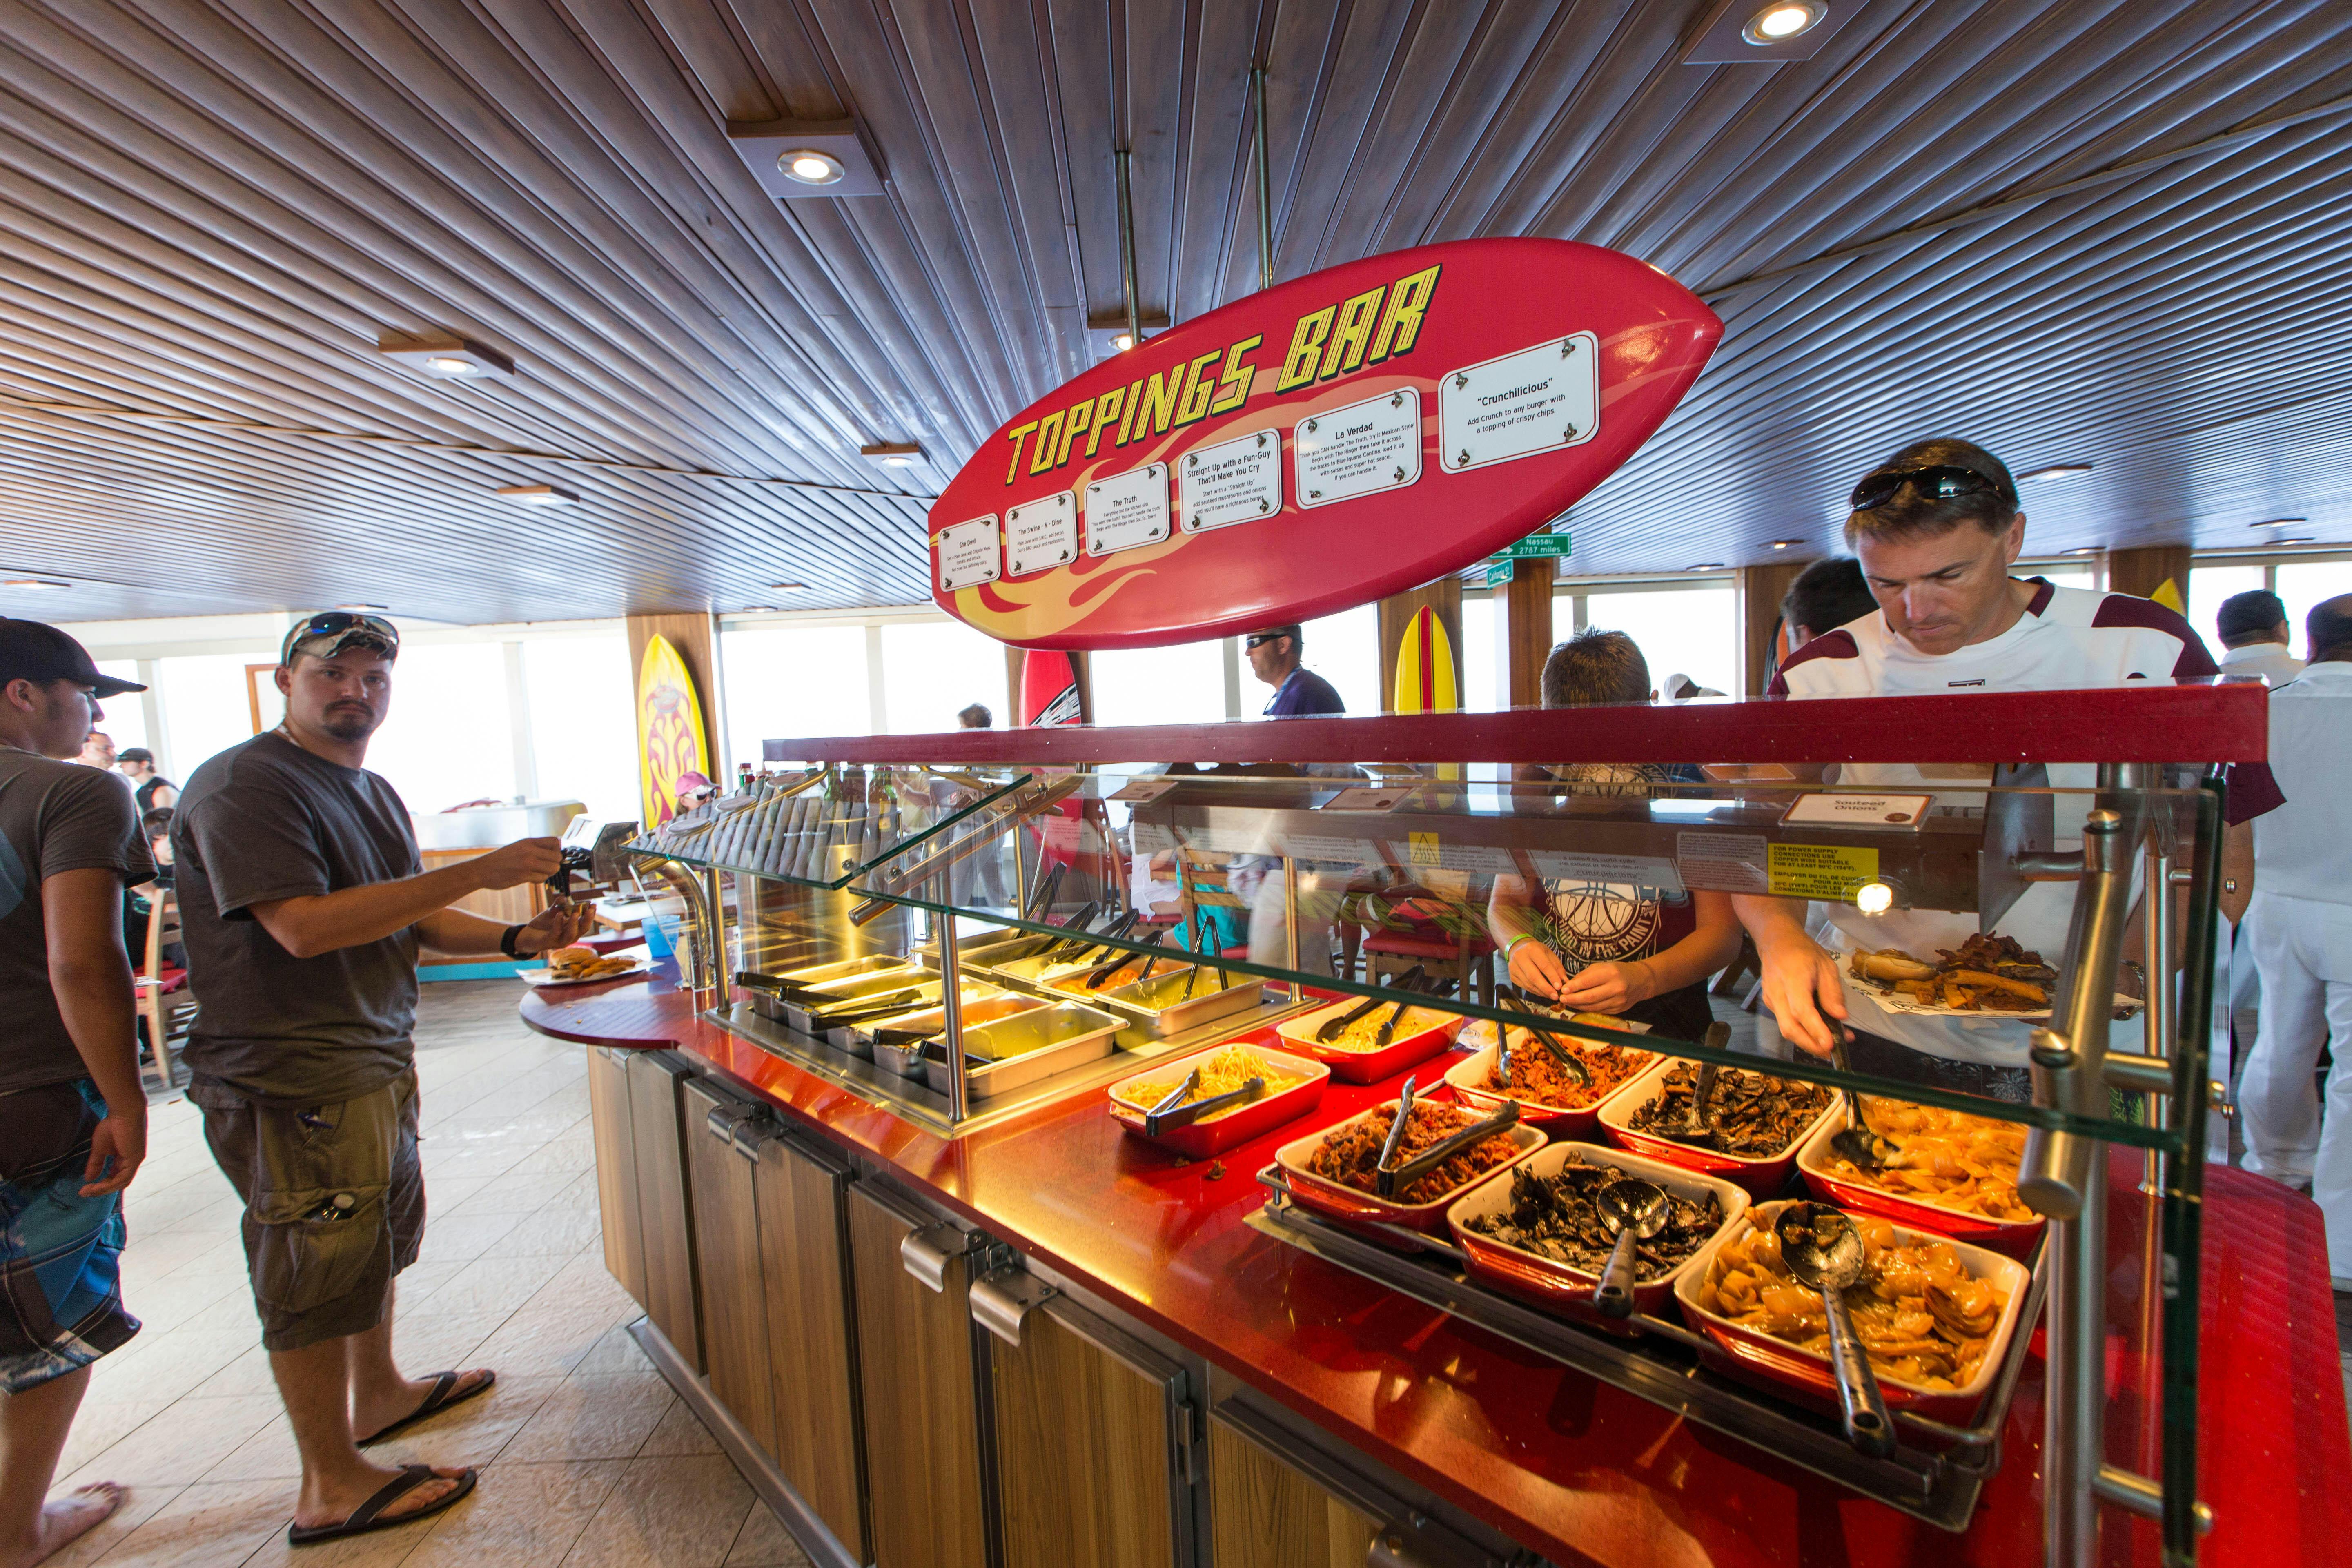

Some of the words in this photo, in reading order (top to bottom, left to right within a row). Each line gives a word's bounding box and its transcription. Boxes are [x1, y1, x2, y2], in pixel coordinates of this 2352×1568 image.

[1005, 333, 1263, 486] TOPPINGS
[1275, 263, 1443, 395] BAR
[1468, 417, 1479, 425] Add
[1481, 411, 1503, 421] Crunch
[1527, 400, 1547, 410] burger
[1550, 394, 1565, 403] with
[1347, 422, 1373, 436] Verdad
[1483, 422, 1506, 432] topping
[1517, 414, 1535, 423] crispy
[1537, 409, 1555, 417] chips.
[1188, 466, 1210, 478] Straight
[1213, 464, 1220, 472] Up
[1223, 459, 1236, 468] with
[1244, 451, 1270, 463] Fun-Guy
[1198, 475, 1215, 486] That'll
[1218, 472, 1233, 480] Make
[1249, 465, 1259, 473] Cry
[1124, 496, 1137, 504] Truth
[1218, 492, 1242, 501] mushrooms
[1229, 499, 1249, 507] righteous
[1519, 546, 1538, 555] 2787
[1559, 920, 1577, 949] HARD
[1579, 941, 1592, 958] IN
[1594, 944, 1621, 959] THE
[1618, 918, 1651, 951] PAINT
